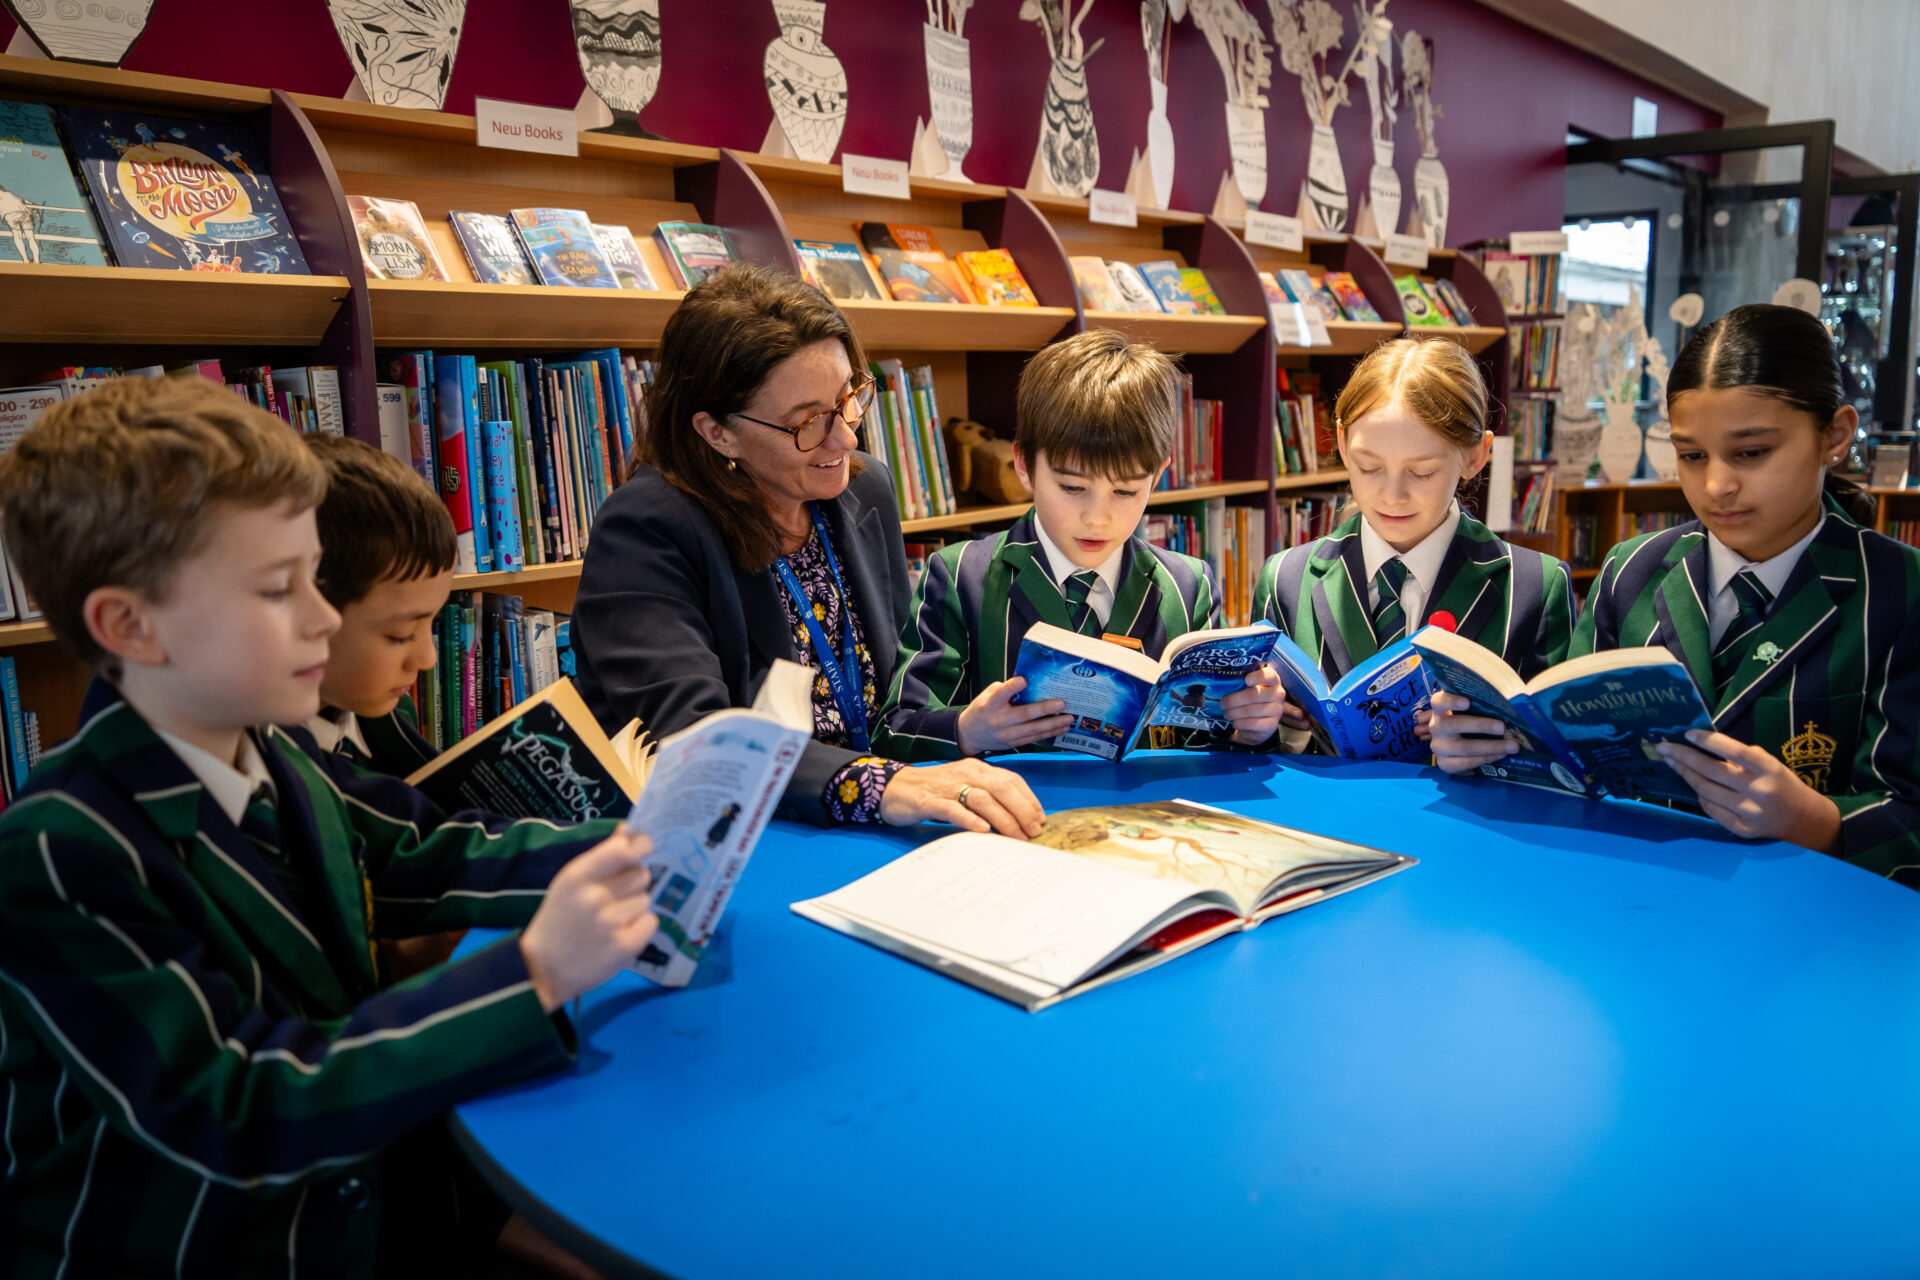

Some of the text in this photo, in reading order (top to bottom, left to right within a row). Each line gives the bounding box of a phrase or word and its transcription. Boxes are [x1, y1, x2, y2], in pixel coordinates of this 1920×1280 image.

[492, 120, 563, 141] New Books
[130, 156, 226, 194] BALLOON
[851, 167, 899, 182] New Books
[374, 241, 414, 254] MONA
[817, 249, 861, 261] Victoria
[385, 256, 416, 269] LISA
[265, 374, 278, 412] WHERE'S THE
[383, 393, 401, 403] 599
[423, 424, 433, 459] SCIENCE
[474, 414, 480, 425] MY
[477, 467, 485, 505] OUTDOORS
[1182, 646, 1250, 662] PERCY
[824, 660, 844, 693] STAFF
[1381, 660, 1408, 680] MURDER
[1646, 685, 1689, 705] HAG
[510, 731, 602, 823] PEGASUS
